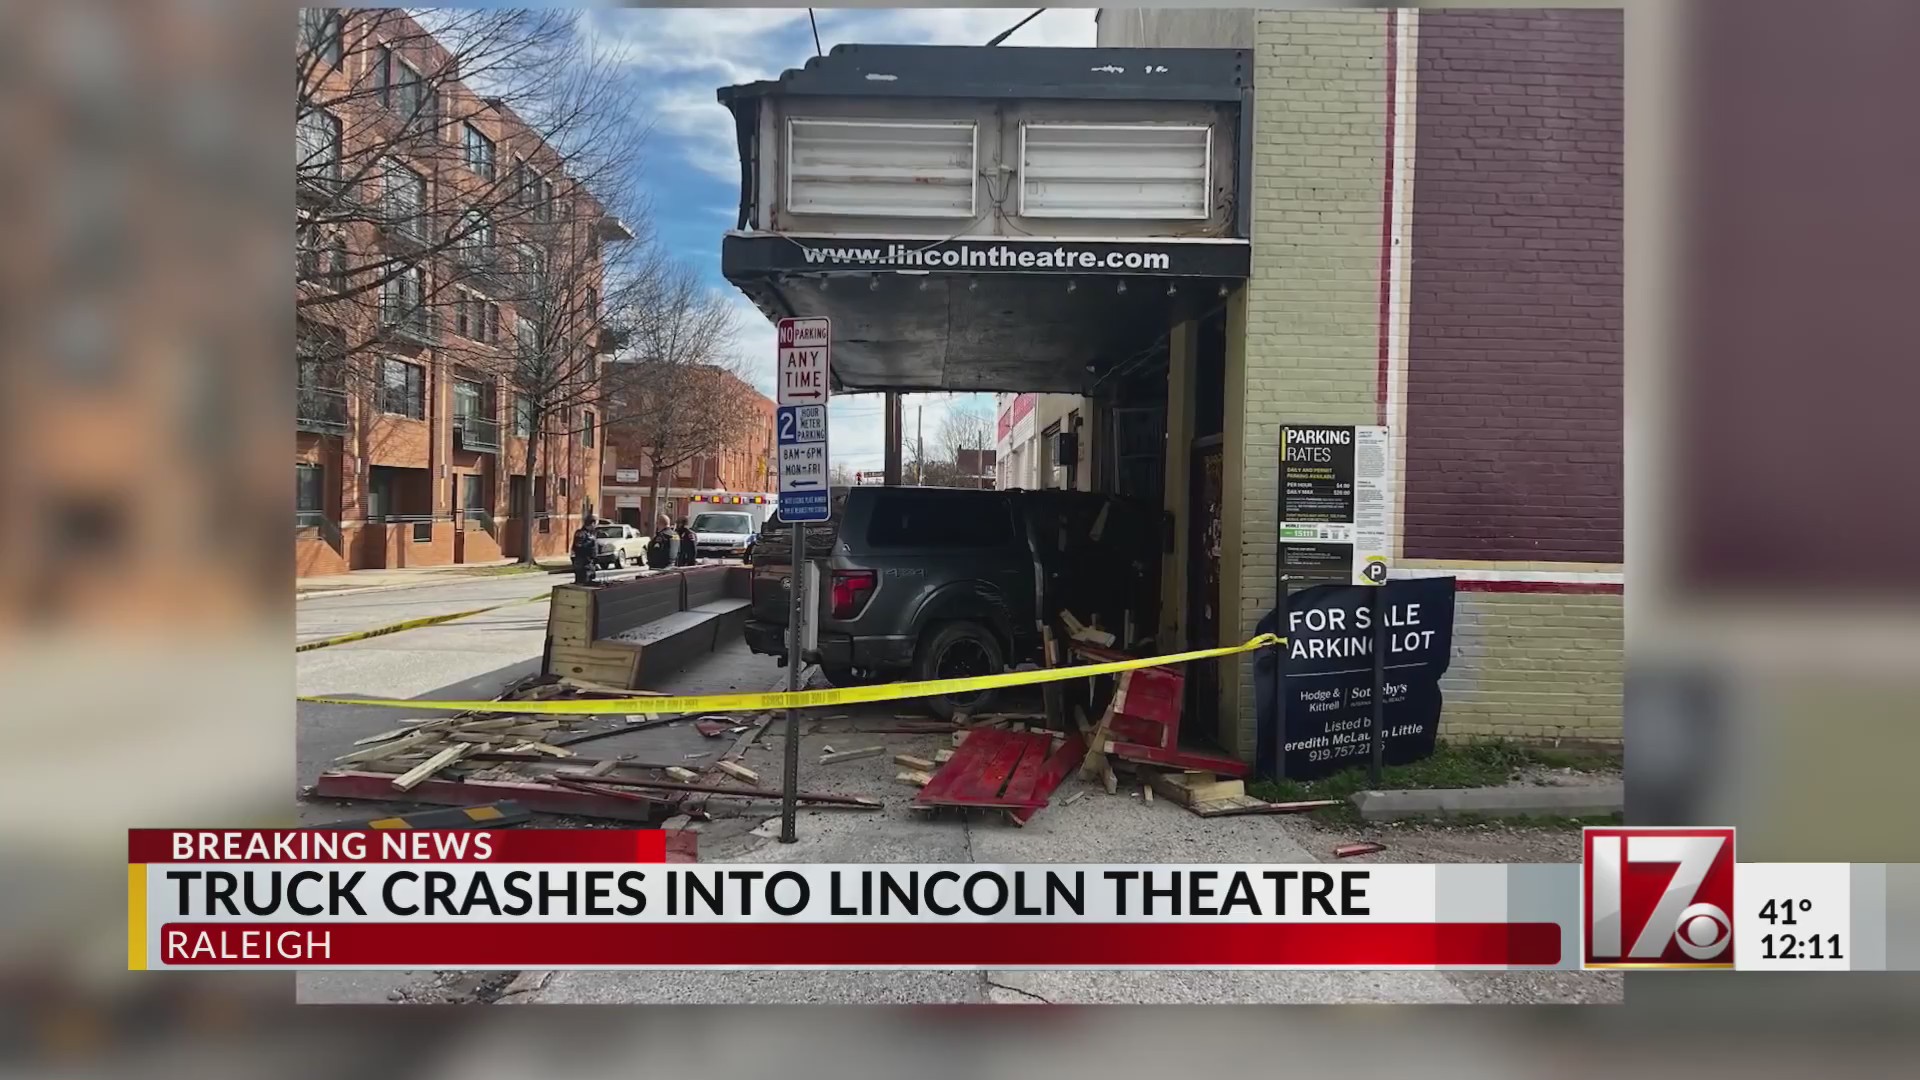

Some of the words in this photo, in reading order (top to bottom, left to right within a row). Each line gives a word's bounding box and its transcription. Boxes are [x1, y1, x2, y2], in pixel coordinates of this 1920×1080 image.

[803, 244, 1170, 269] www.lincolntheatre.com
[779, 326, 793, 344] NO
[795, 327, 827, 340] PARKING
[787, 351, 819, 368] ANY
[785, 371, 821, 388] TIME
[801, 407, 819, 417] HOUR
[780, 412, 794, 439] 2
[800, 418, 821, 428] METER
[797, 429, 825, 442] PARKING
[1287, 430, 1350, 445] PARKING
[783, 447, 822, 460] 8AM-6PM
[1287, 447, 1331, 462] RATES
[785, 463, 821, 476] MON-FRI
[1371, 565, 1382, 579] P
[1289, 608, 1345, 632] FOR
[1355, 603, 1420, 629] SLE
[1291, 636, 1373, 659] ARKIN
[1392, 631, 1435, 652] LOT
[1301, 690, 1331, 701] Hodge
[1333, 688, 1340, 697] &
[1352, 682, 1408, 699] Sotby's
[1309, 701, 1340, 712] Kittrell
[1324, 718, 1361, 733] Listed
[1284, 736, 1329, 751] eredith
[1391, 723, 1423, 737] Little
